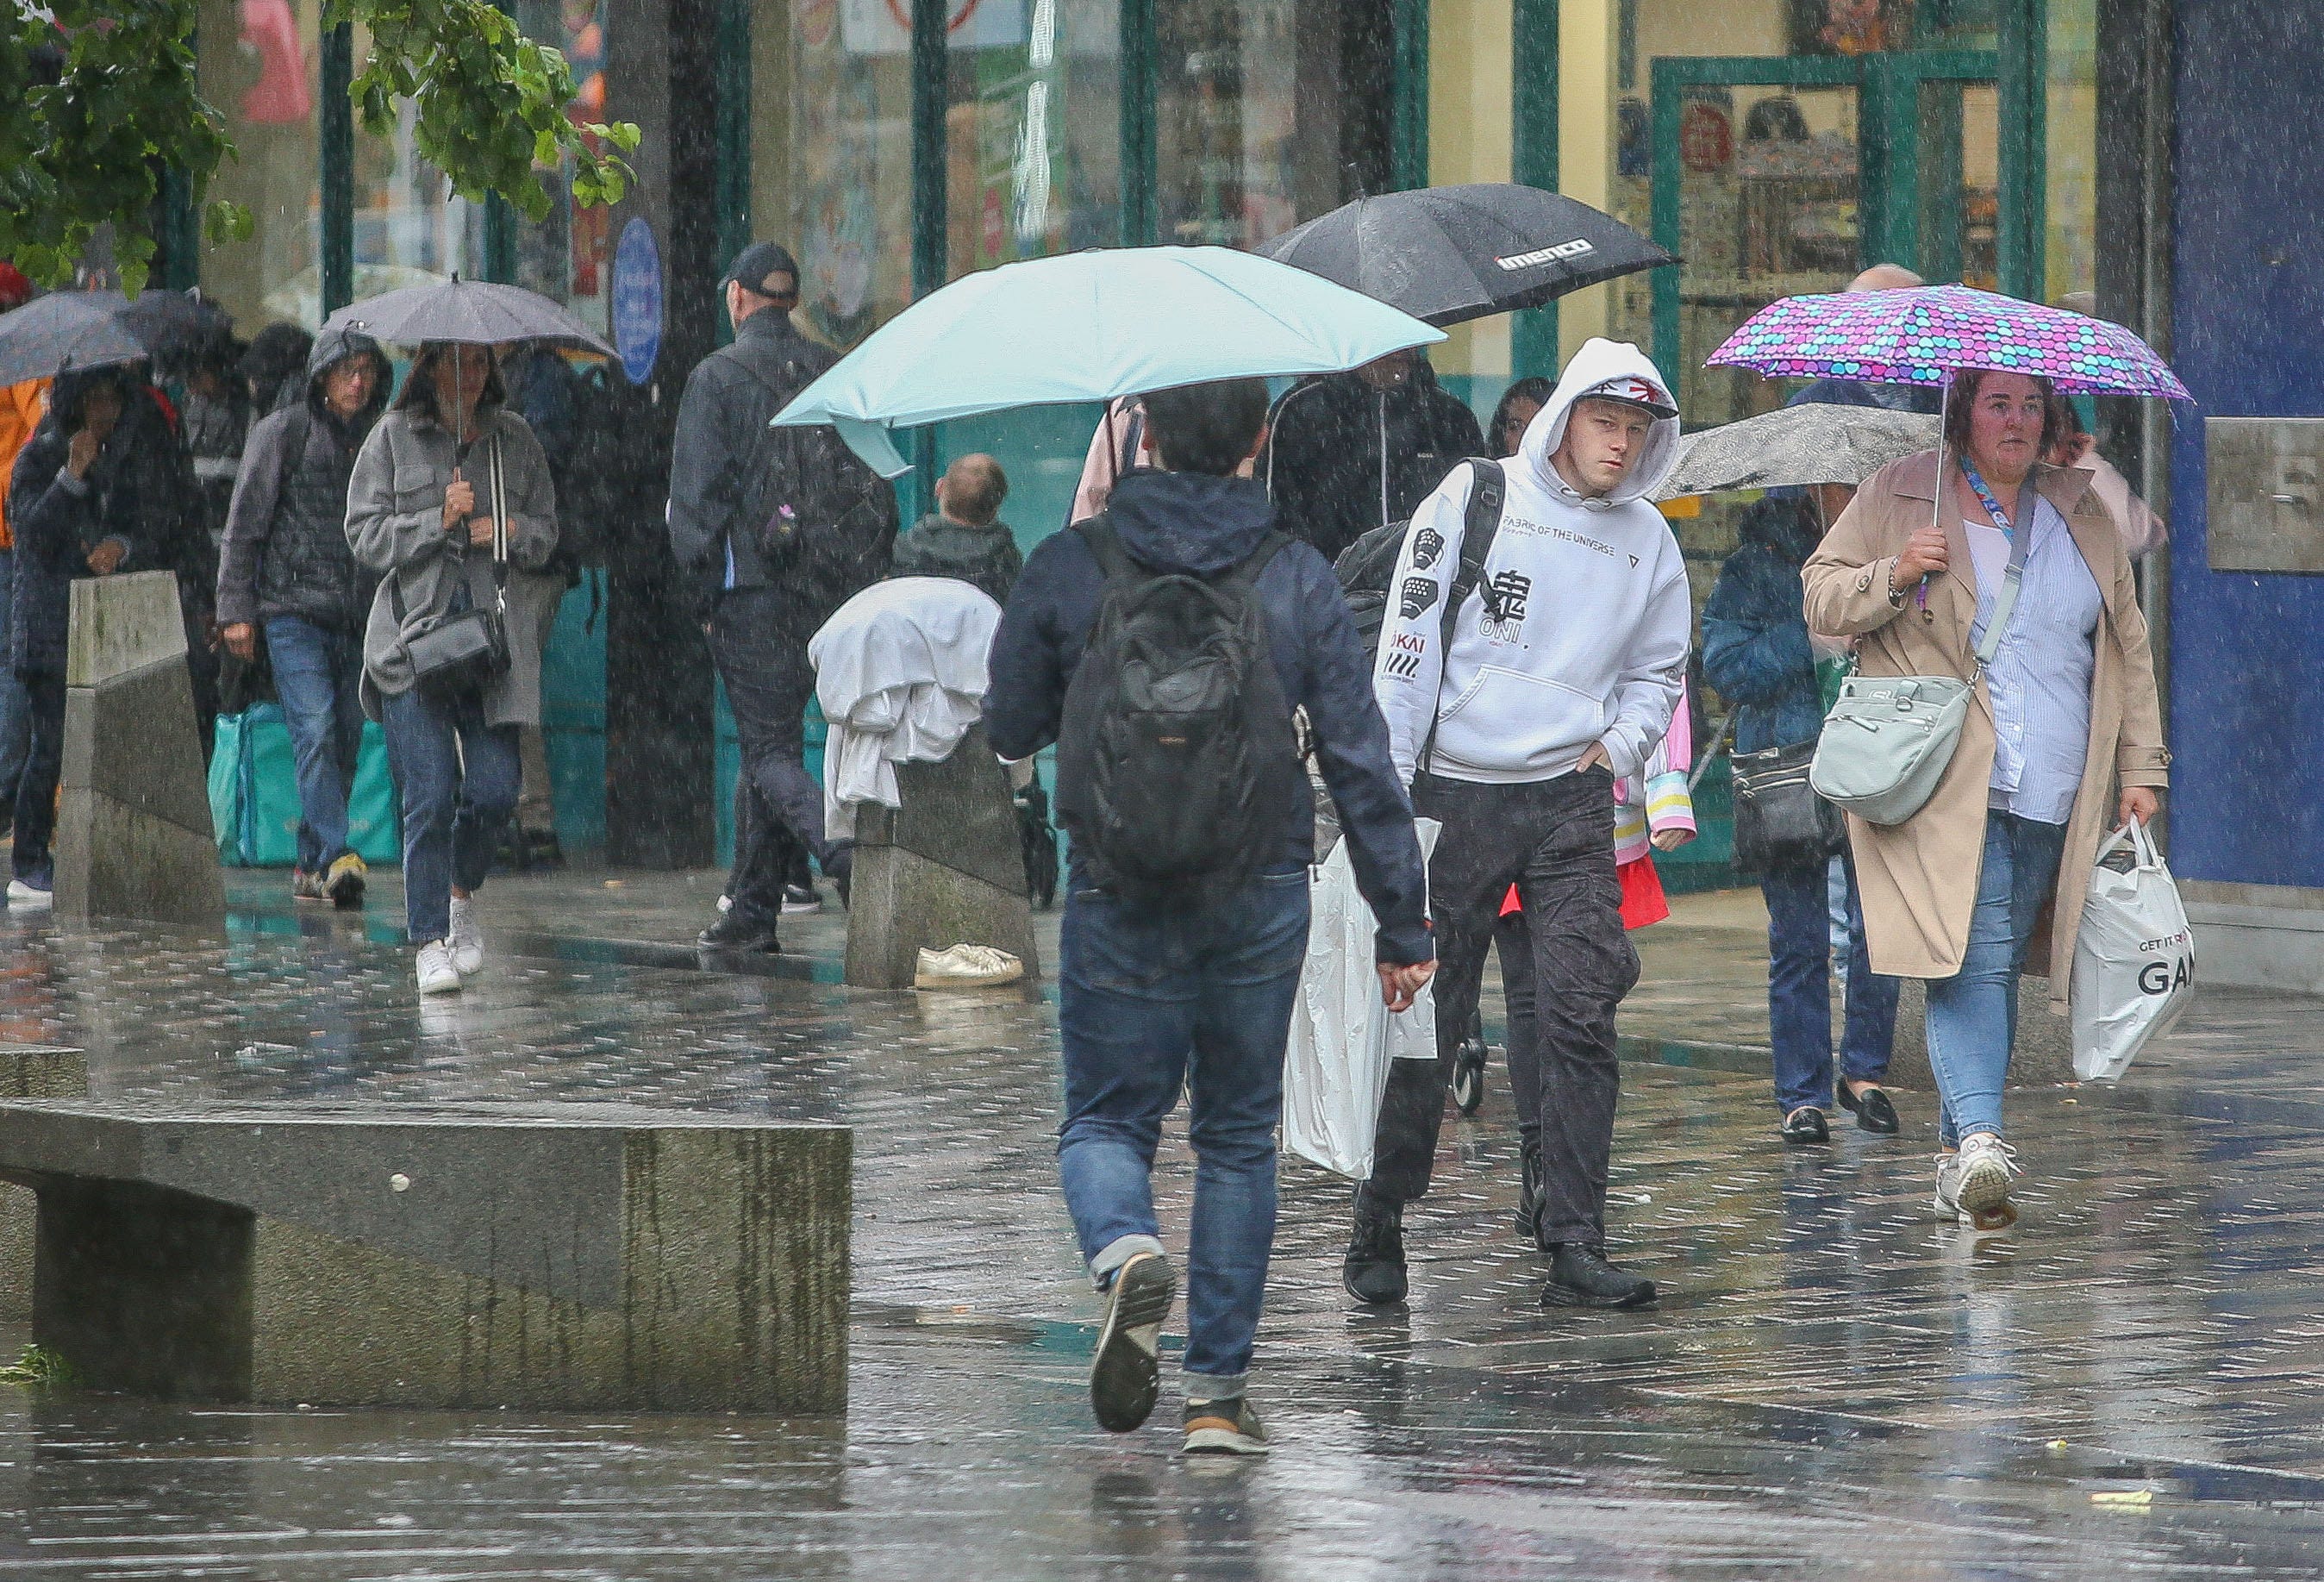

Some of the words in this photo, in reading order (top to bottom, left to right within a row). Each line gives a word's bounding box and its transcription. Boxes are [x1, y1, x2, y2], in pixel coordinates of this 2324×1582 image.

[1502, 516, 1535, 532] FABRIC
[1538, 525, 1551, 535] OF
[1552, 528, 1572, 541] THE
[1573, 534, 1615, 557] UNIVERSE
[1479, 617, 1522, 644] ONI
[2140, 939, 2162, 952] GET
[2164, 936, 2173, 947] IT
